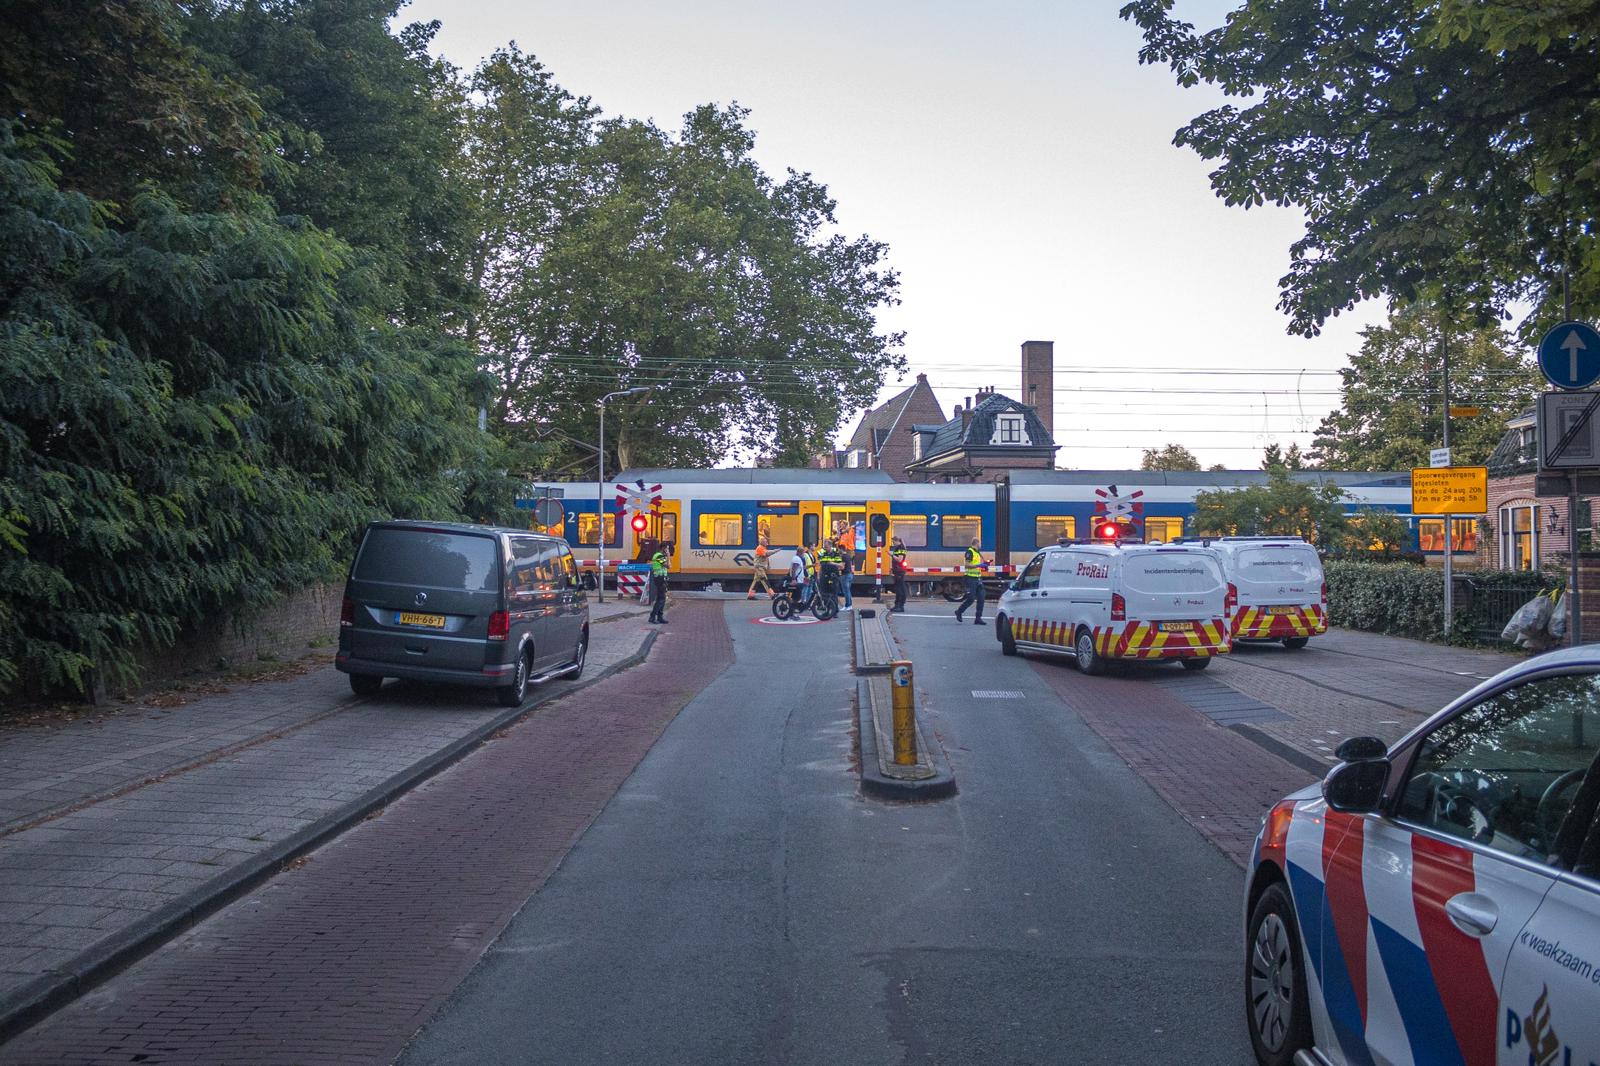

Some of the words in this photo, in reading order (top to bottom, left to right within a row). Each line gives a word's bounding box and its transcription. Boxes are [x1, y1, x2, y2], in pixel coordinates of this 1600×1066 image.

[567, 512, 575, 522] 2
[931, 515, 938, 525] 2
[1406, 517, 1413, 529] 1
[1076, 562, 1109, 579] ProRail
[402, 614, 442, 625] VHH-66-T
[1530, 935, 1591, 978] waakzaam
